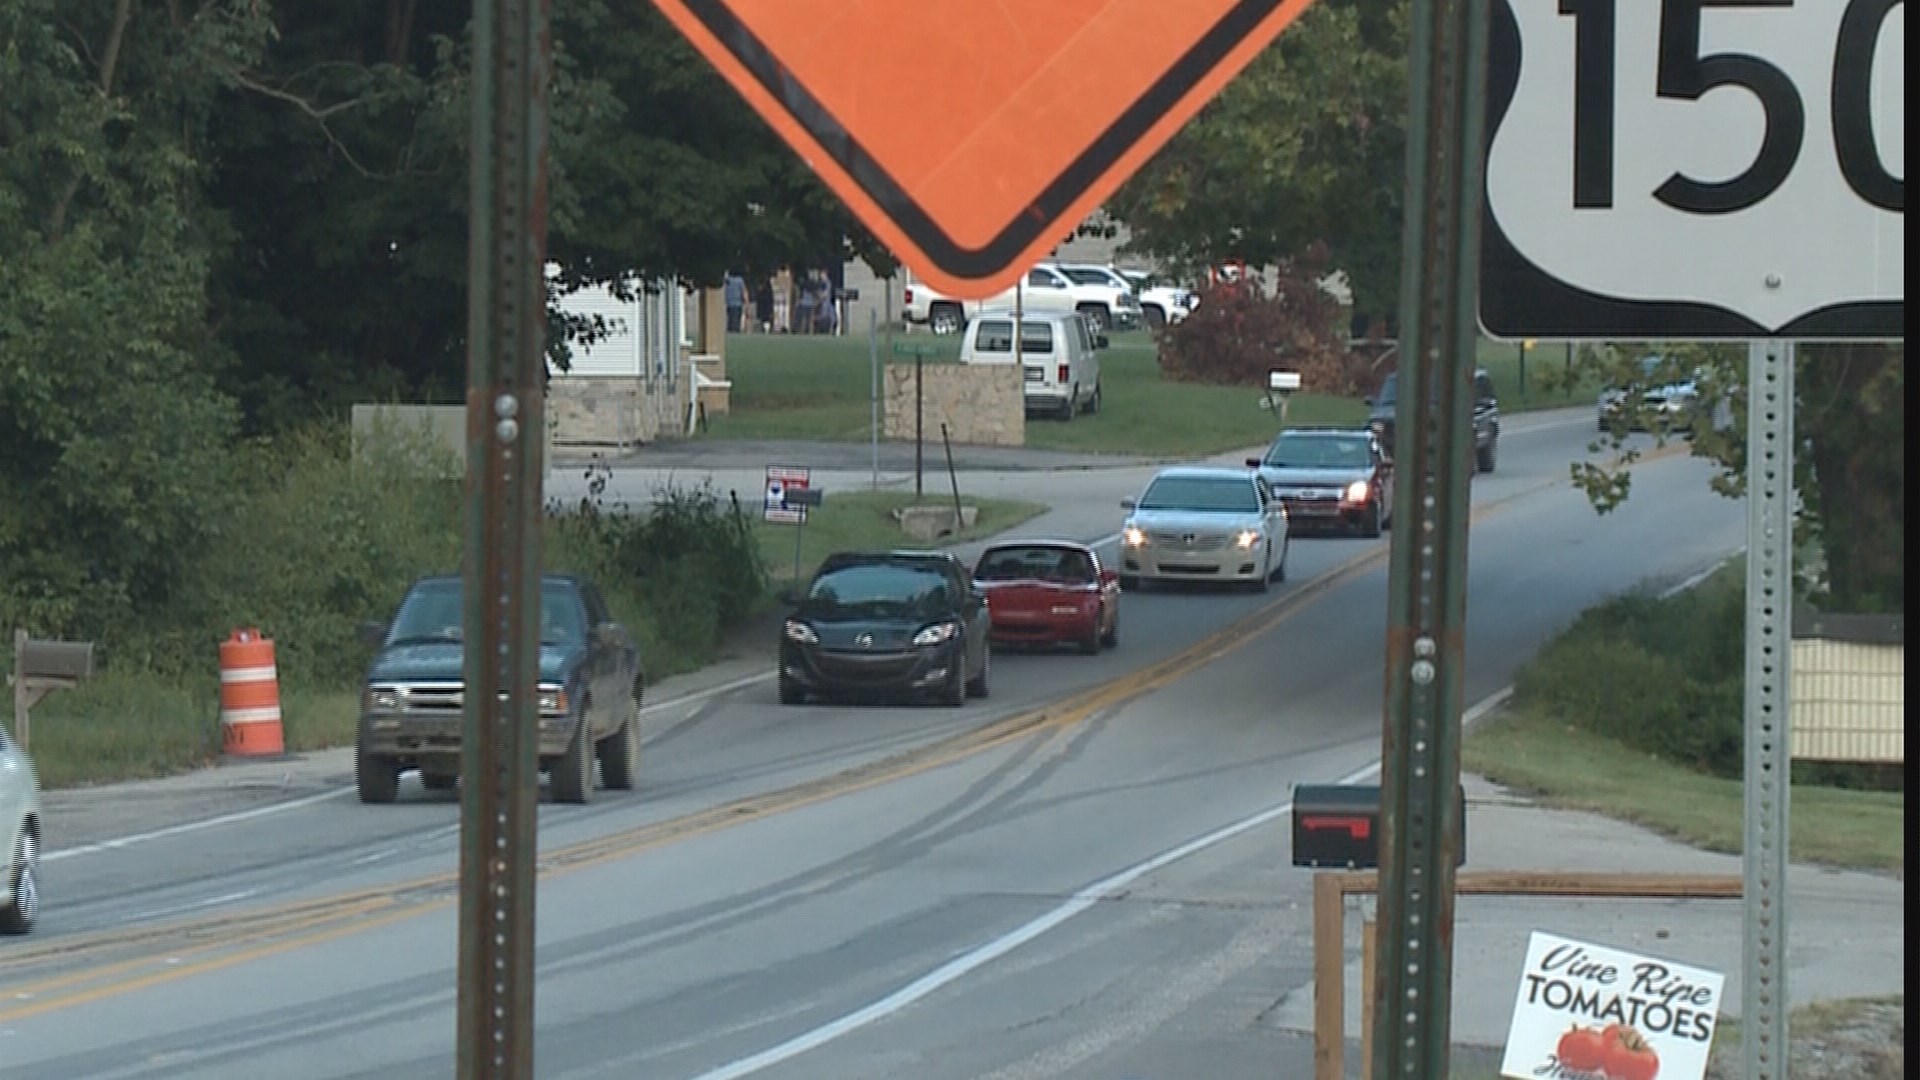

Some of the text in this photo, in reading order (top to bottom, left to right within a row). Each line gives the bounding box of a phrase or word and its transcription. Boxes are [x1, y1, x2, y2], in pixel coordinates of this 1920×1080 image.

[1526, 973, 1712, 1042] TOMATOES
[1540, 943, 1712, 1006] Vine Ripe
